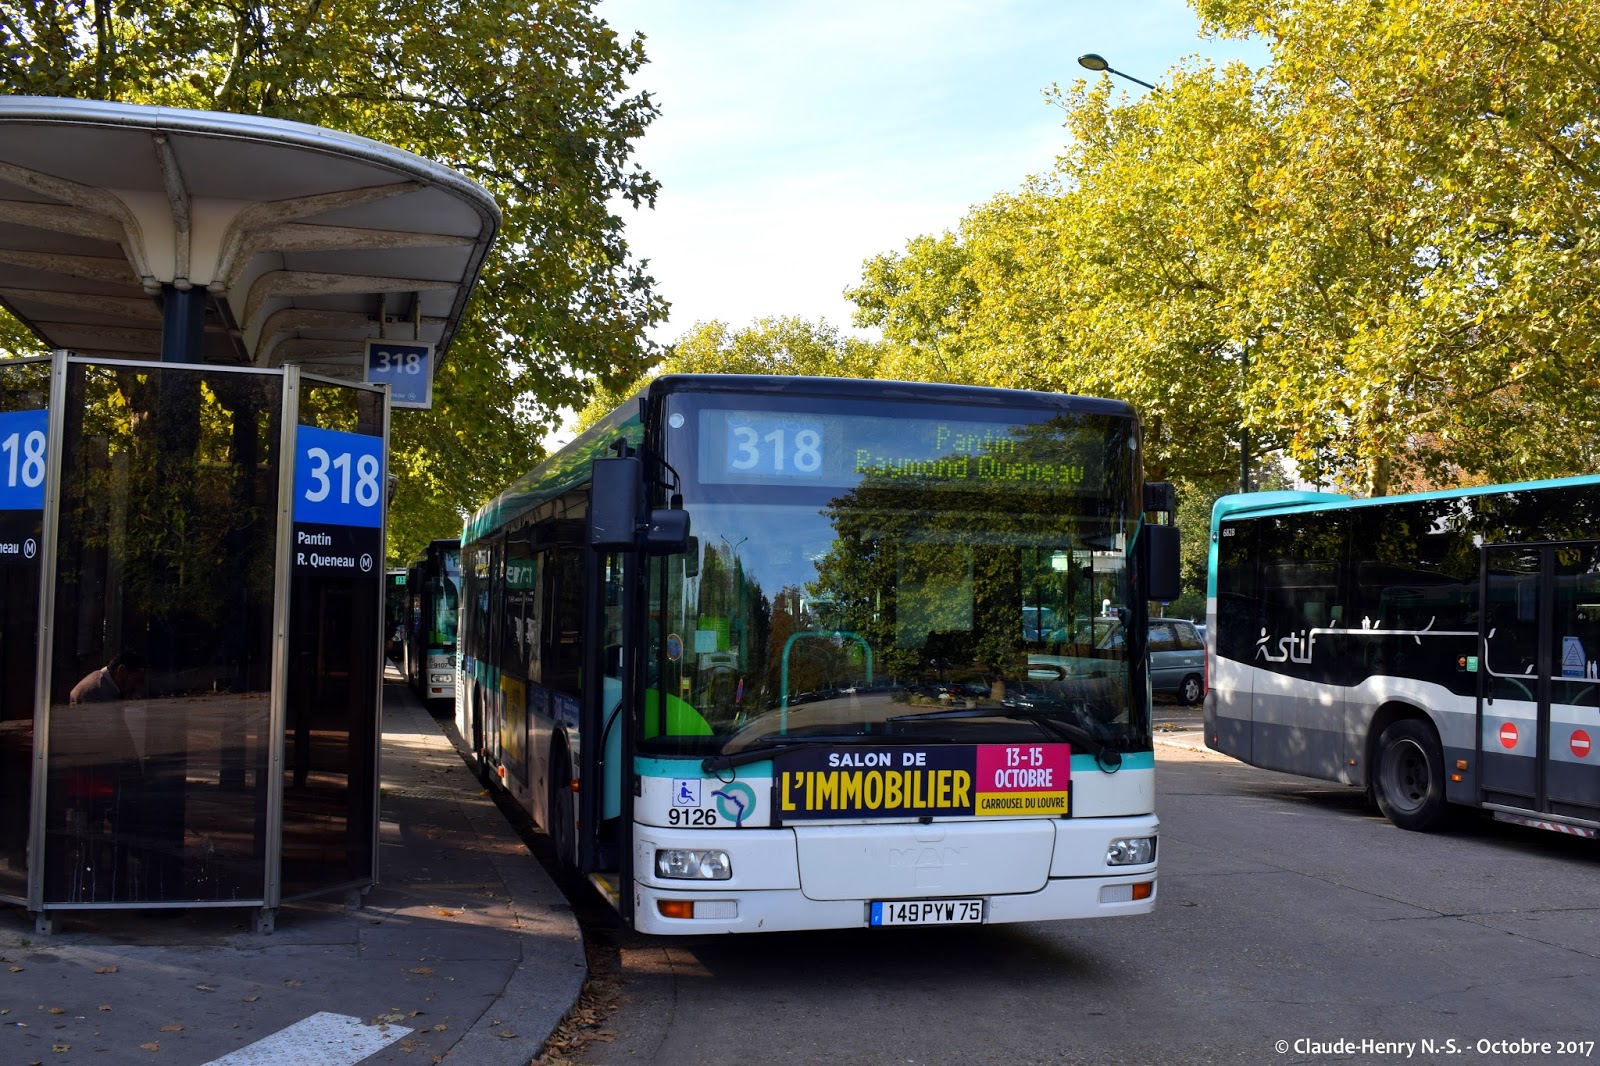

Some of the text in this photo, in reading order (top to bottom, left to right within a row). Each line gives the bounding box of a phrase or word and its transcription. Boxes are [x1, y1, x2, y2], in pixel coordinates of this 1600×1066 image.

[376, 351, 420, 375] 318
[732, 426, 822, 472] 318
[936, 426, 1015, 453] Pantin
[855, 449, 1085, 483] Raymond Queneau
[304, 447, 380, 507] 318
[298, 531, 332, 546] Pantin
[297, 552, 308, 565] R.
[310, 553, 355, 568] Queneau
[1278, 629, 1316, 664] stif
[828, 752, 926, 767] SALON DE
[1006, 747, 1043, 767] 13-15
[994, 768, 1053, 788] OCTOBRE
[981, 797, 1065, 810] CARROUSEL DU LOUVRE
[668, 808, 717, 826] 9126
